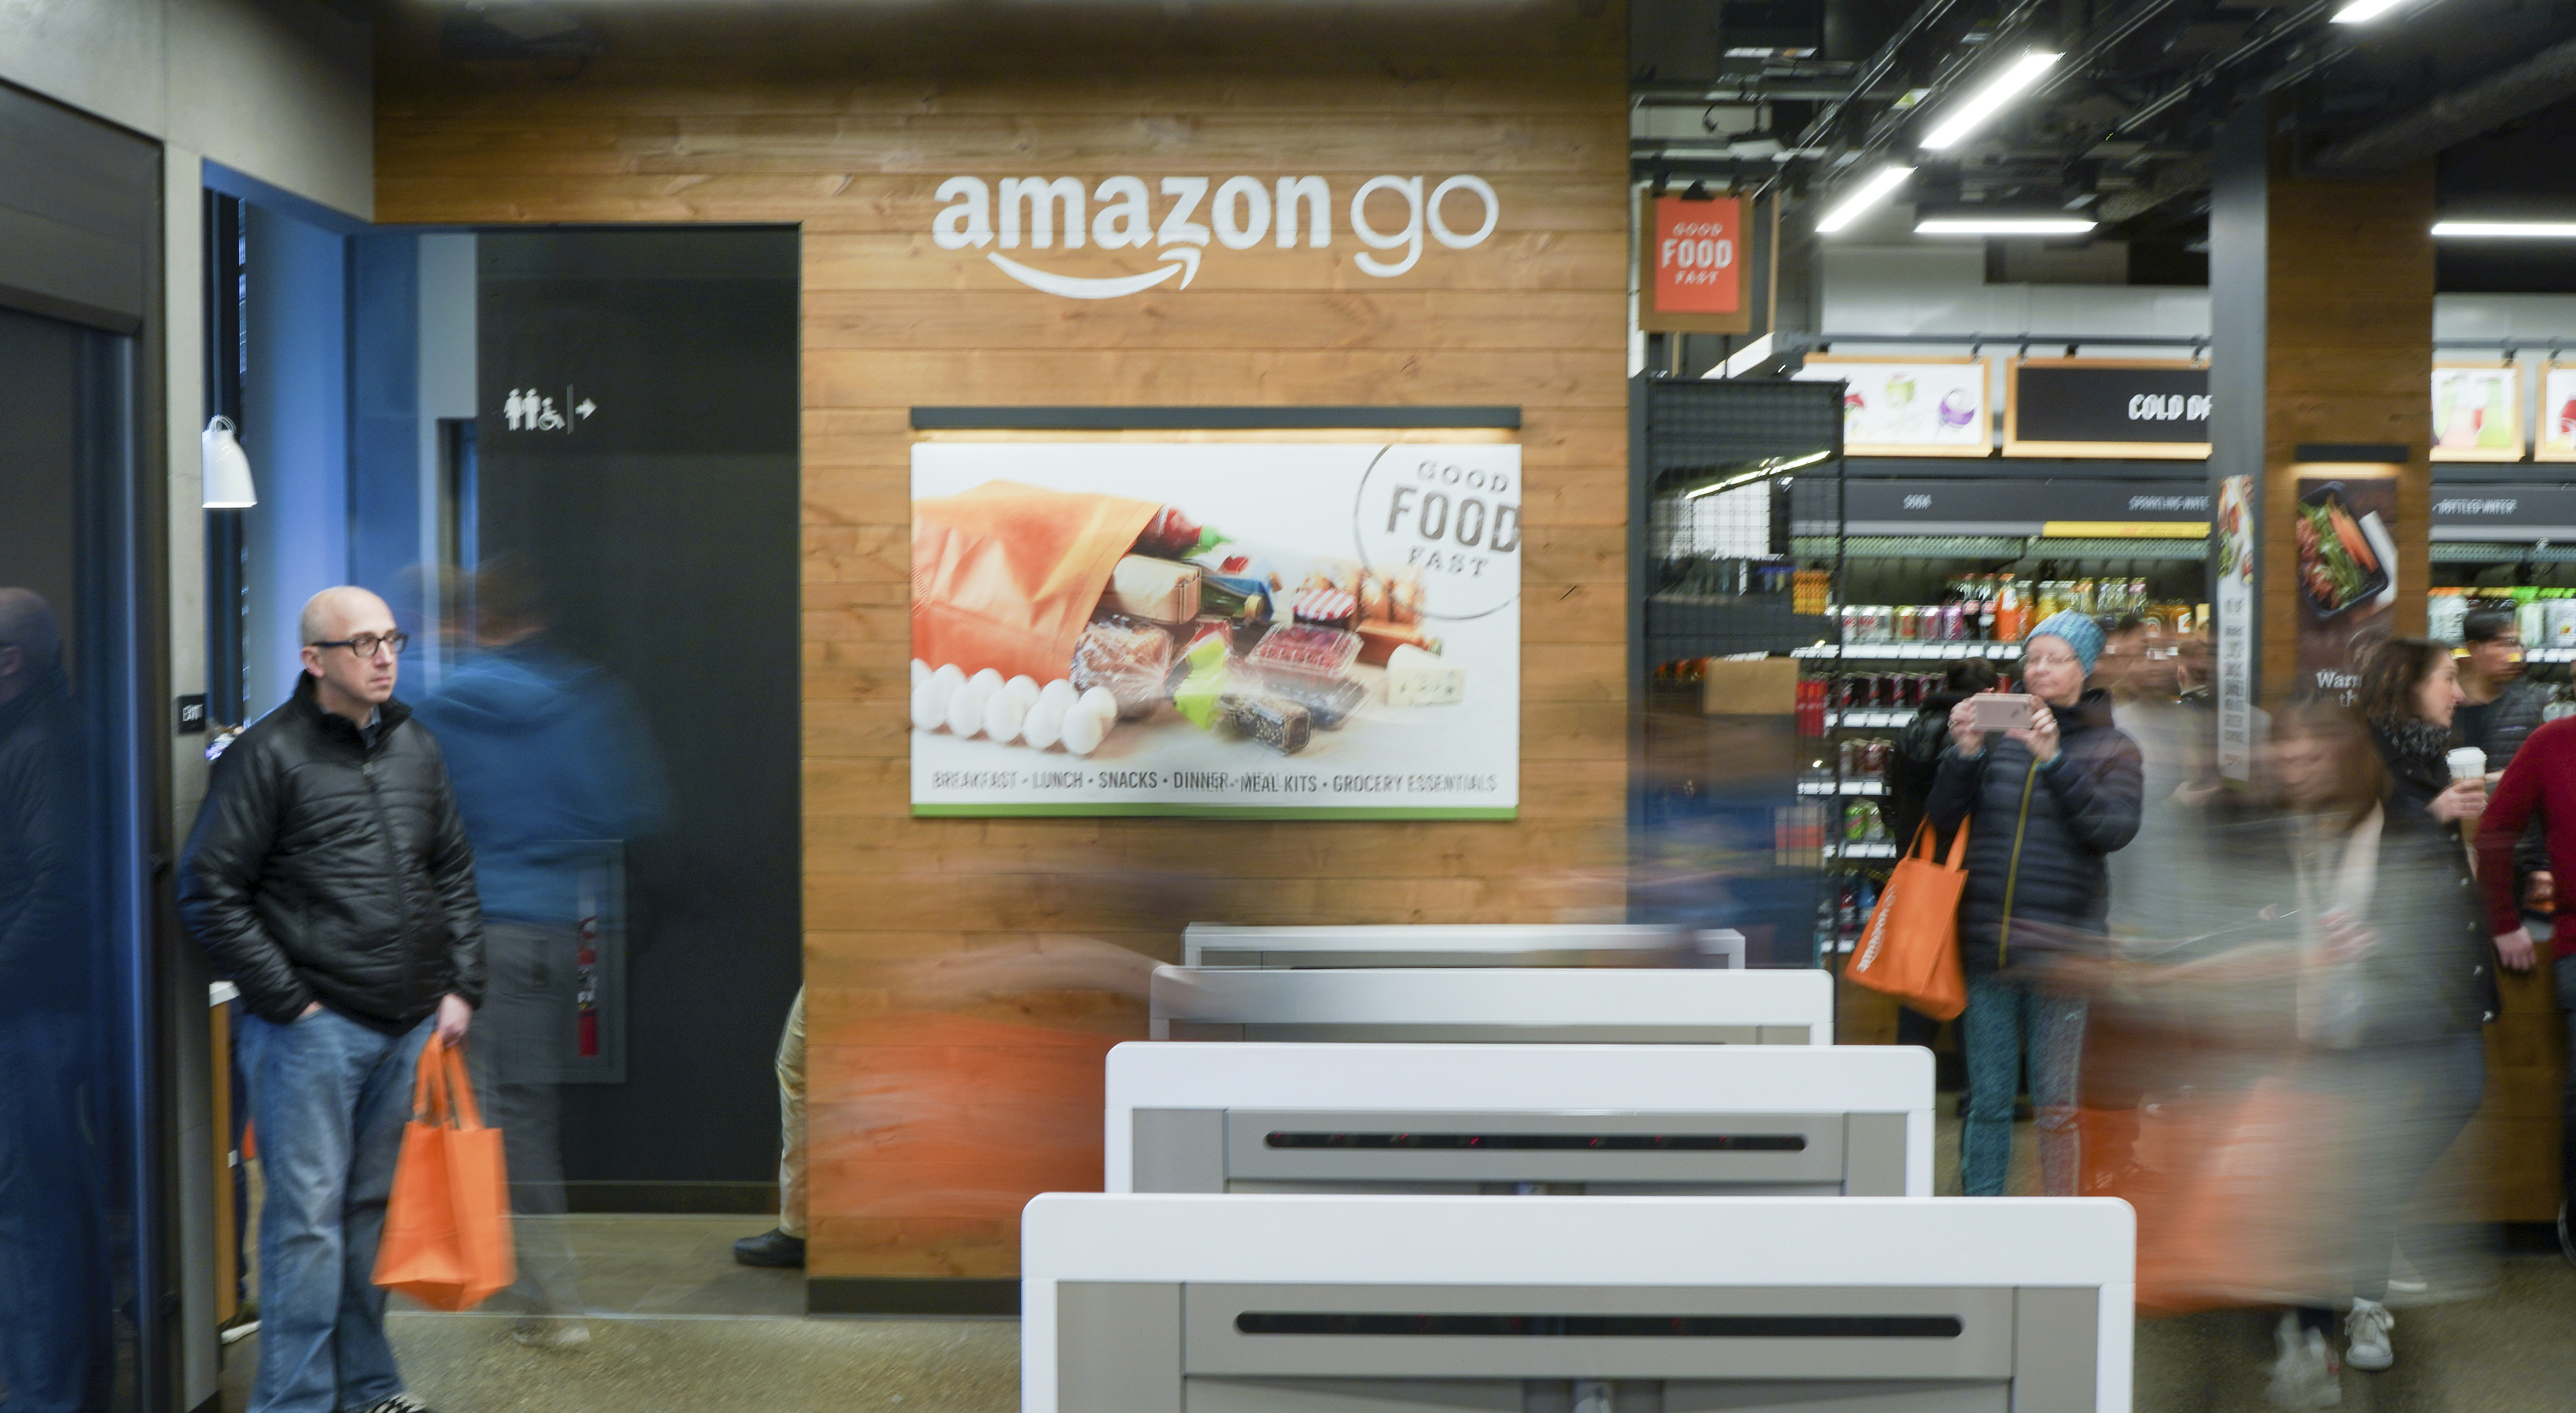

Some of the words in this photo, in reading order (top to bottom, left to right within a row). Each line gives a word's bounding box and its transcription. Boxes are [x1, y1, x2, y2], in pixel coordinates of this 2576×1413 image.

[932, 175, 1332, 250] amazon
[1350, 174, 1499, 278] go
[1672, 222, 1723, 237] GOOD
[1661, 238, 1733, 269] FOOD
[1675, 270, 1719, 285] FAST
[2128, 393, 2185, 421] COLD
[1418, 460, 1509, 493] GOOD
[1385, 484, 1521, 553] FOOD
[1407, 545, 1489, 577] FAST
[932, 771, 1018, 789] BREAKFAST
[1032, 771, 1084, 789] LUNCH
[1099, 771, 1157, 789] SNACKS
[1173, 771, 1231, 792] DINNER
[1240, 772, 1280, 793] MEAL
[1284, 773, 1317, 793] KITS
[1333, 773, 1402, 793] GROCERY
[1407, 773, 1497, 793] ESSENTIALS
